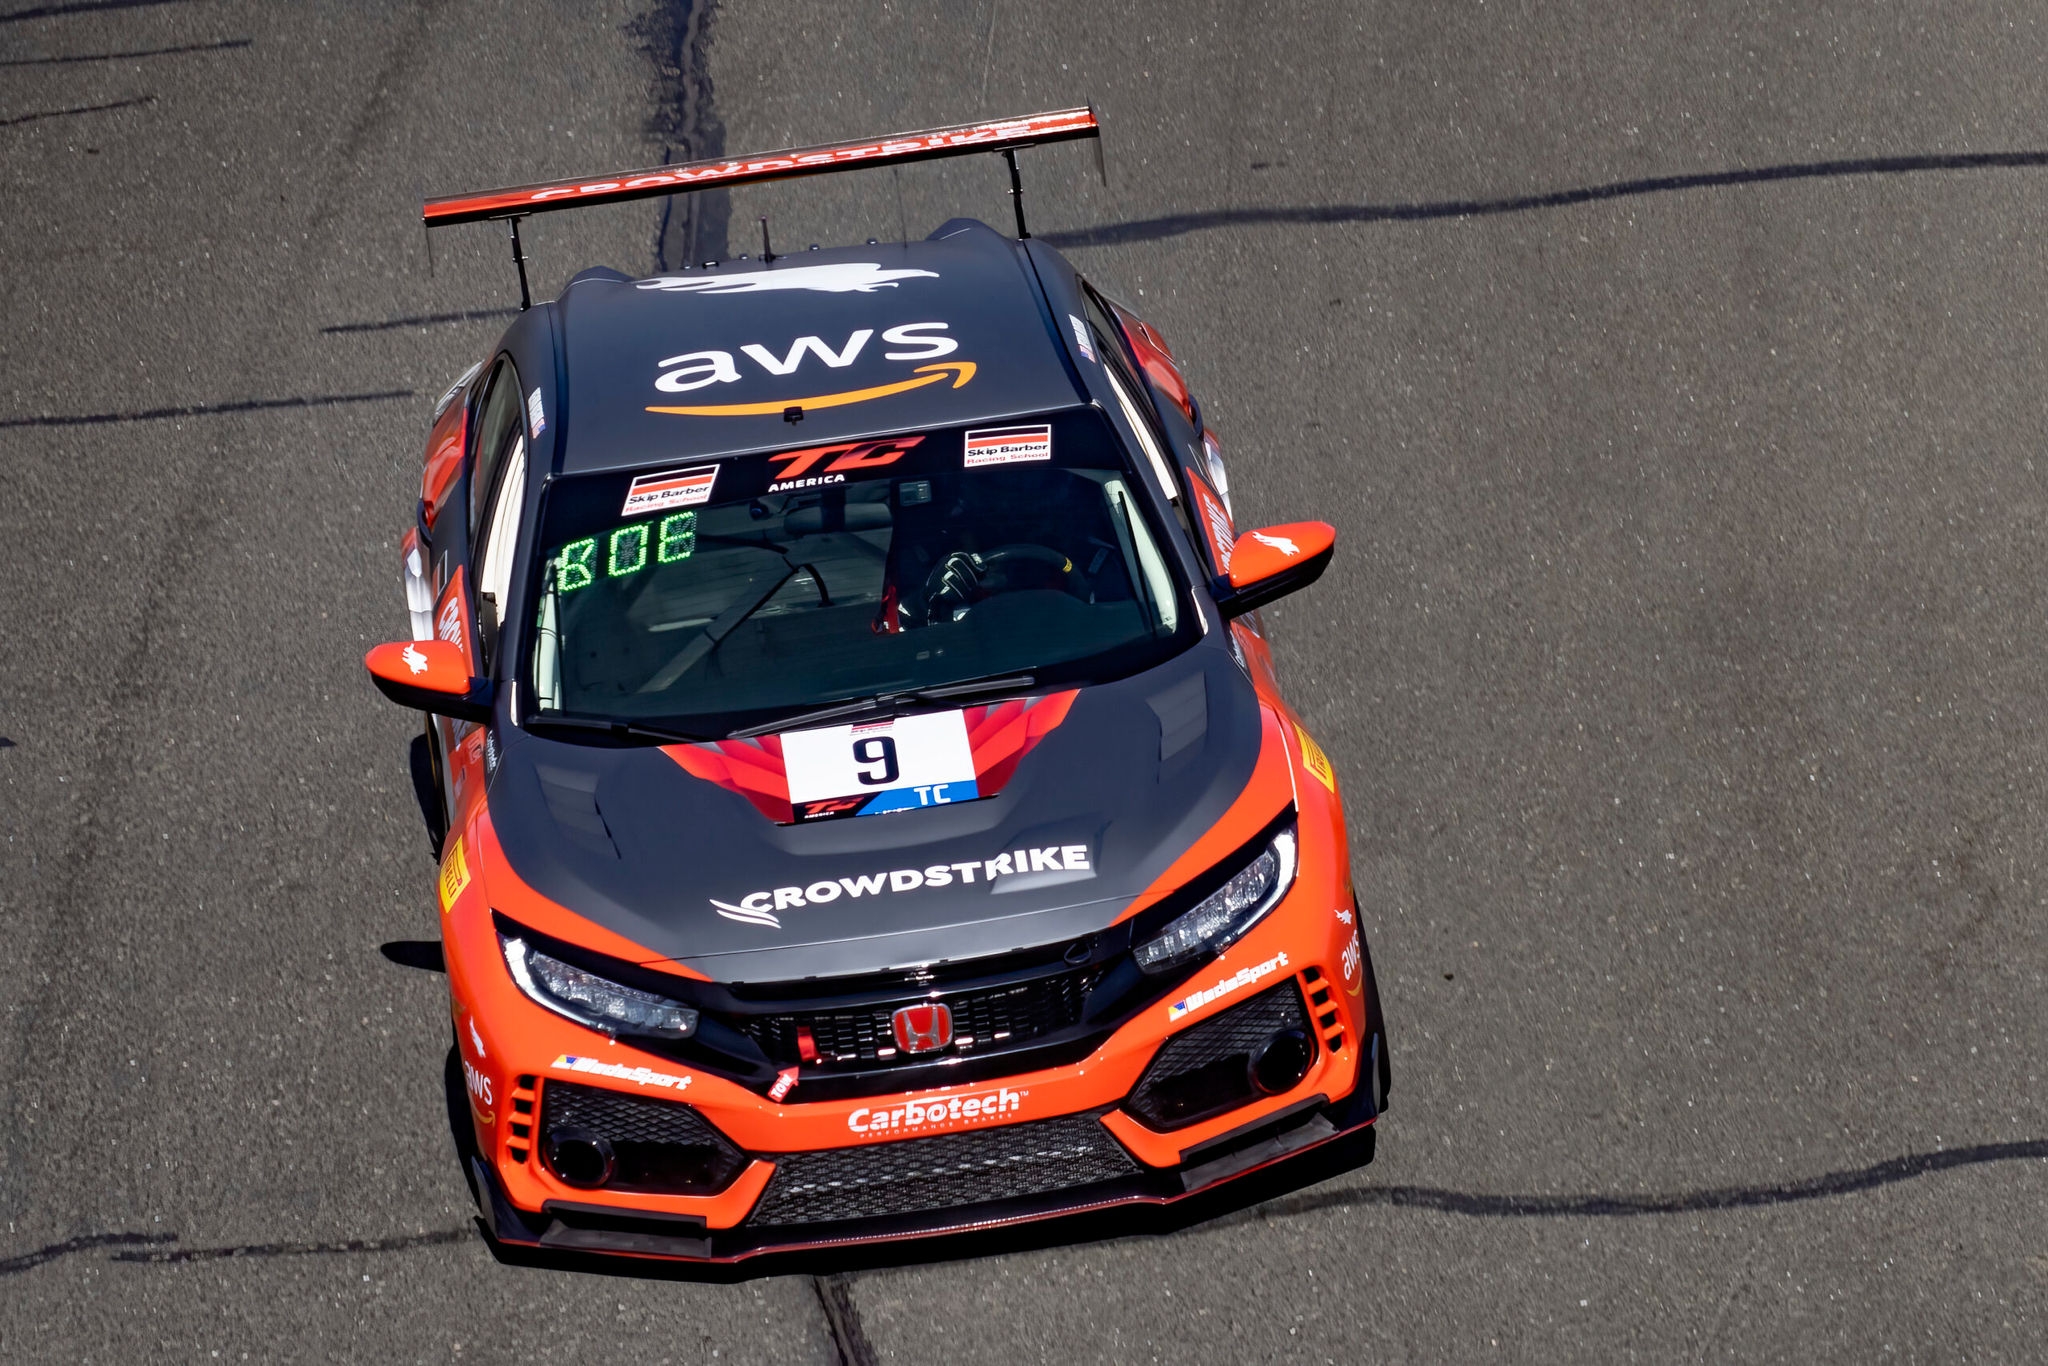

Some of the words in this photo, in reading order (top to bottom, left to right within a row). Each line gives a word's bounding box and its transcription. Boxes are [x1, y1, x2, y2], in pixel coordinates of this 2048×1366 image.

[654, 321, 959, 393] aws
[768, 435, 927, 480] TC
[966, 456, 1007, 465] Racing
[1010, 451, 1049, 460] School
[967, 447, 998, 457] Skip
[1000, 444, 1049, 453] Barber
[628, 494, 659, 505] Skip
[661, 485, 710, 499] Barber
[768, 474, 846, 493] AMERICA
[625, 501, 665, 513] Racing
[852, 736, 900, 786] 9
[914, 784, 951, 806] TC
[738, 843, 1092, 914] CROWDSTRIKE
[770, 1073, 793, 1098] TOW
[847, 1088, 1020, 1133] Carbotech
[859, 1122, 954, 1139] PERFORMANCE
[963, 1113, 1013, 1125] BRAKES
